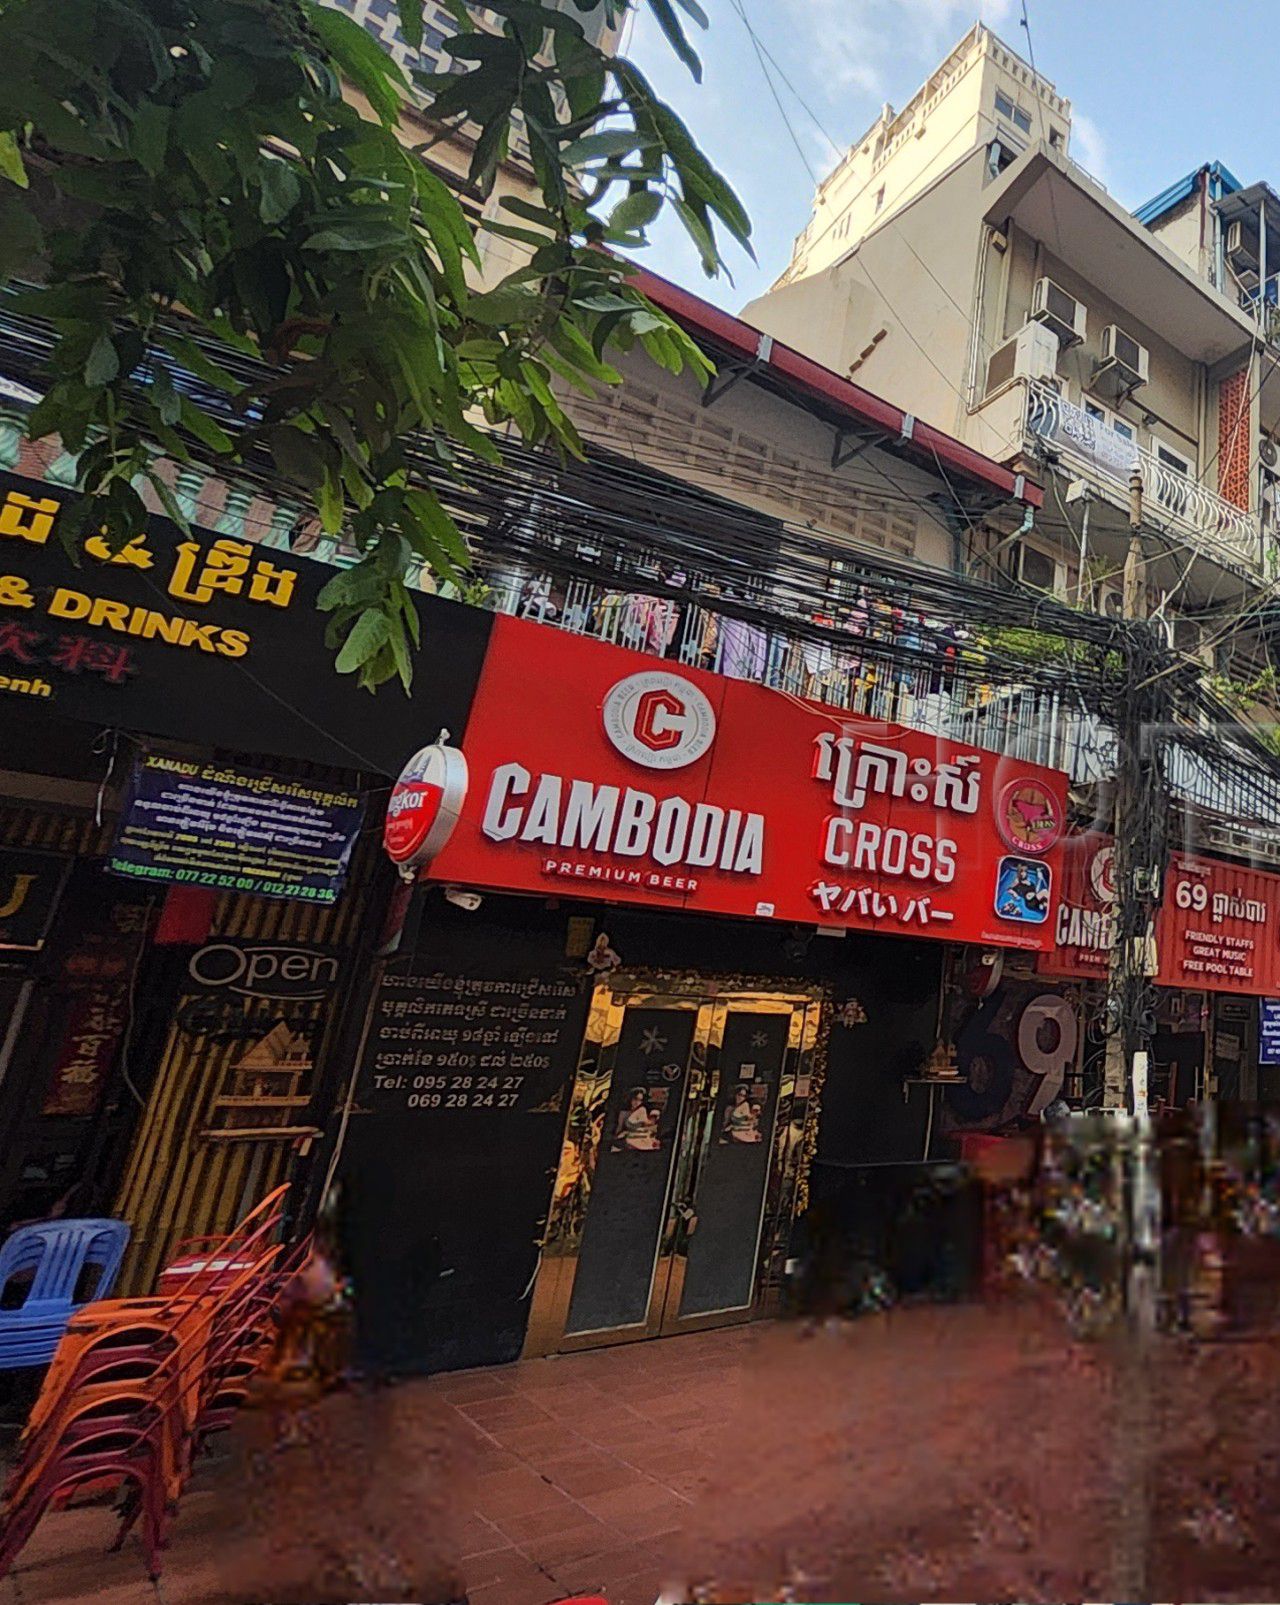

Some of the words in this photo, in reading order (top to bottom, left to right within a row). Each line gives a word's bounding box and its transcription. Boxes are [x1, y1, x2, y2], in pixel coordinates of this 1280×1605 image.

[47, 588, 250, 658] DRINKS
[146, 756, 199, 776] XANADU
[482, 763, 765, 875] CAMBODIA
[824, 817, 958, 883] CROSS
[1011, 836, 1043, 851] CROSS
[175, 869, 198, 883] 077
[200, 872, 216, 885] 22
[217, 874, 233, 887] 52
[263, 881, 283, 894] 012
[546, 861, 641, 883] PREMIUM
[650, 874, 699, 891] BEER
[1176, 881, 1207, 911] 69
[1055, 903, 1117, 951] CAMB
[1185, 930, 1224, 945] FRIENDLY
[1226, 936, 1254, 949] STAFFS
[189, 944, 338, 988] Open
[1193, 946, 1221, 958] GREAT
[1222, 949, 1247, 961] MUSIC
[1183, 960, 1204, 972] FREE
[1206, 963, 1228, 975] POOL
[1230, 966, 1254, 978] TABLE
[374, 1075, 407, 1090] Tel:
[413, 1076, 447, 1090] 095
[450, 1076, 473, 1090] 28
[476, 1076, 500, 1090] 24
[502, 1076, 525, 1090] 27
[407, 1094, 441, 1108] 069
[445, 1093, 468, 1108] 28
[472, 1093, 494, 1108] 24
[498, 1093, 519, 1108] 27
